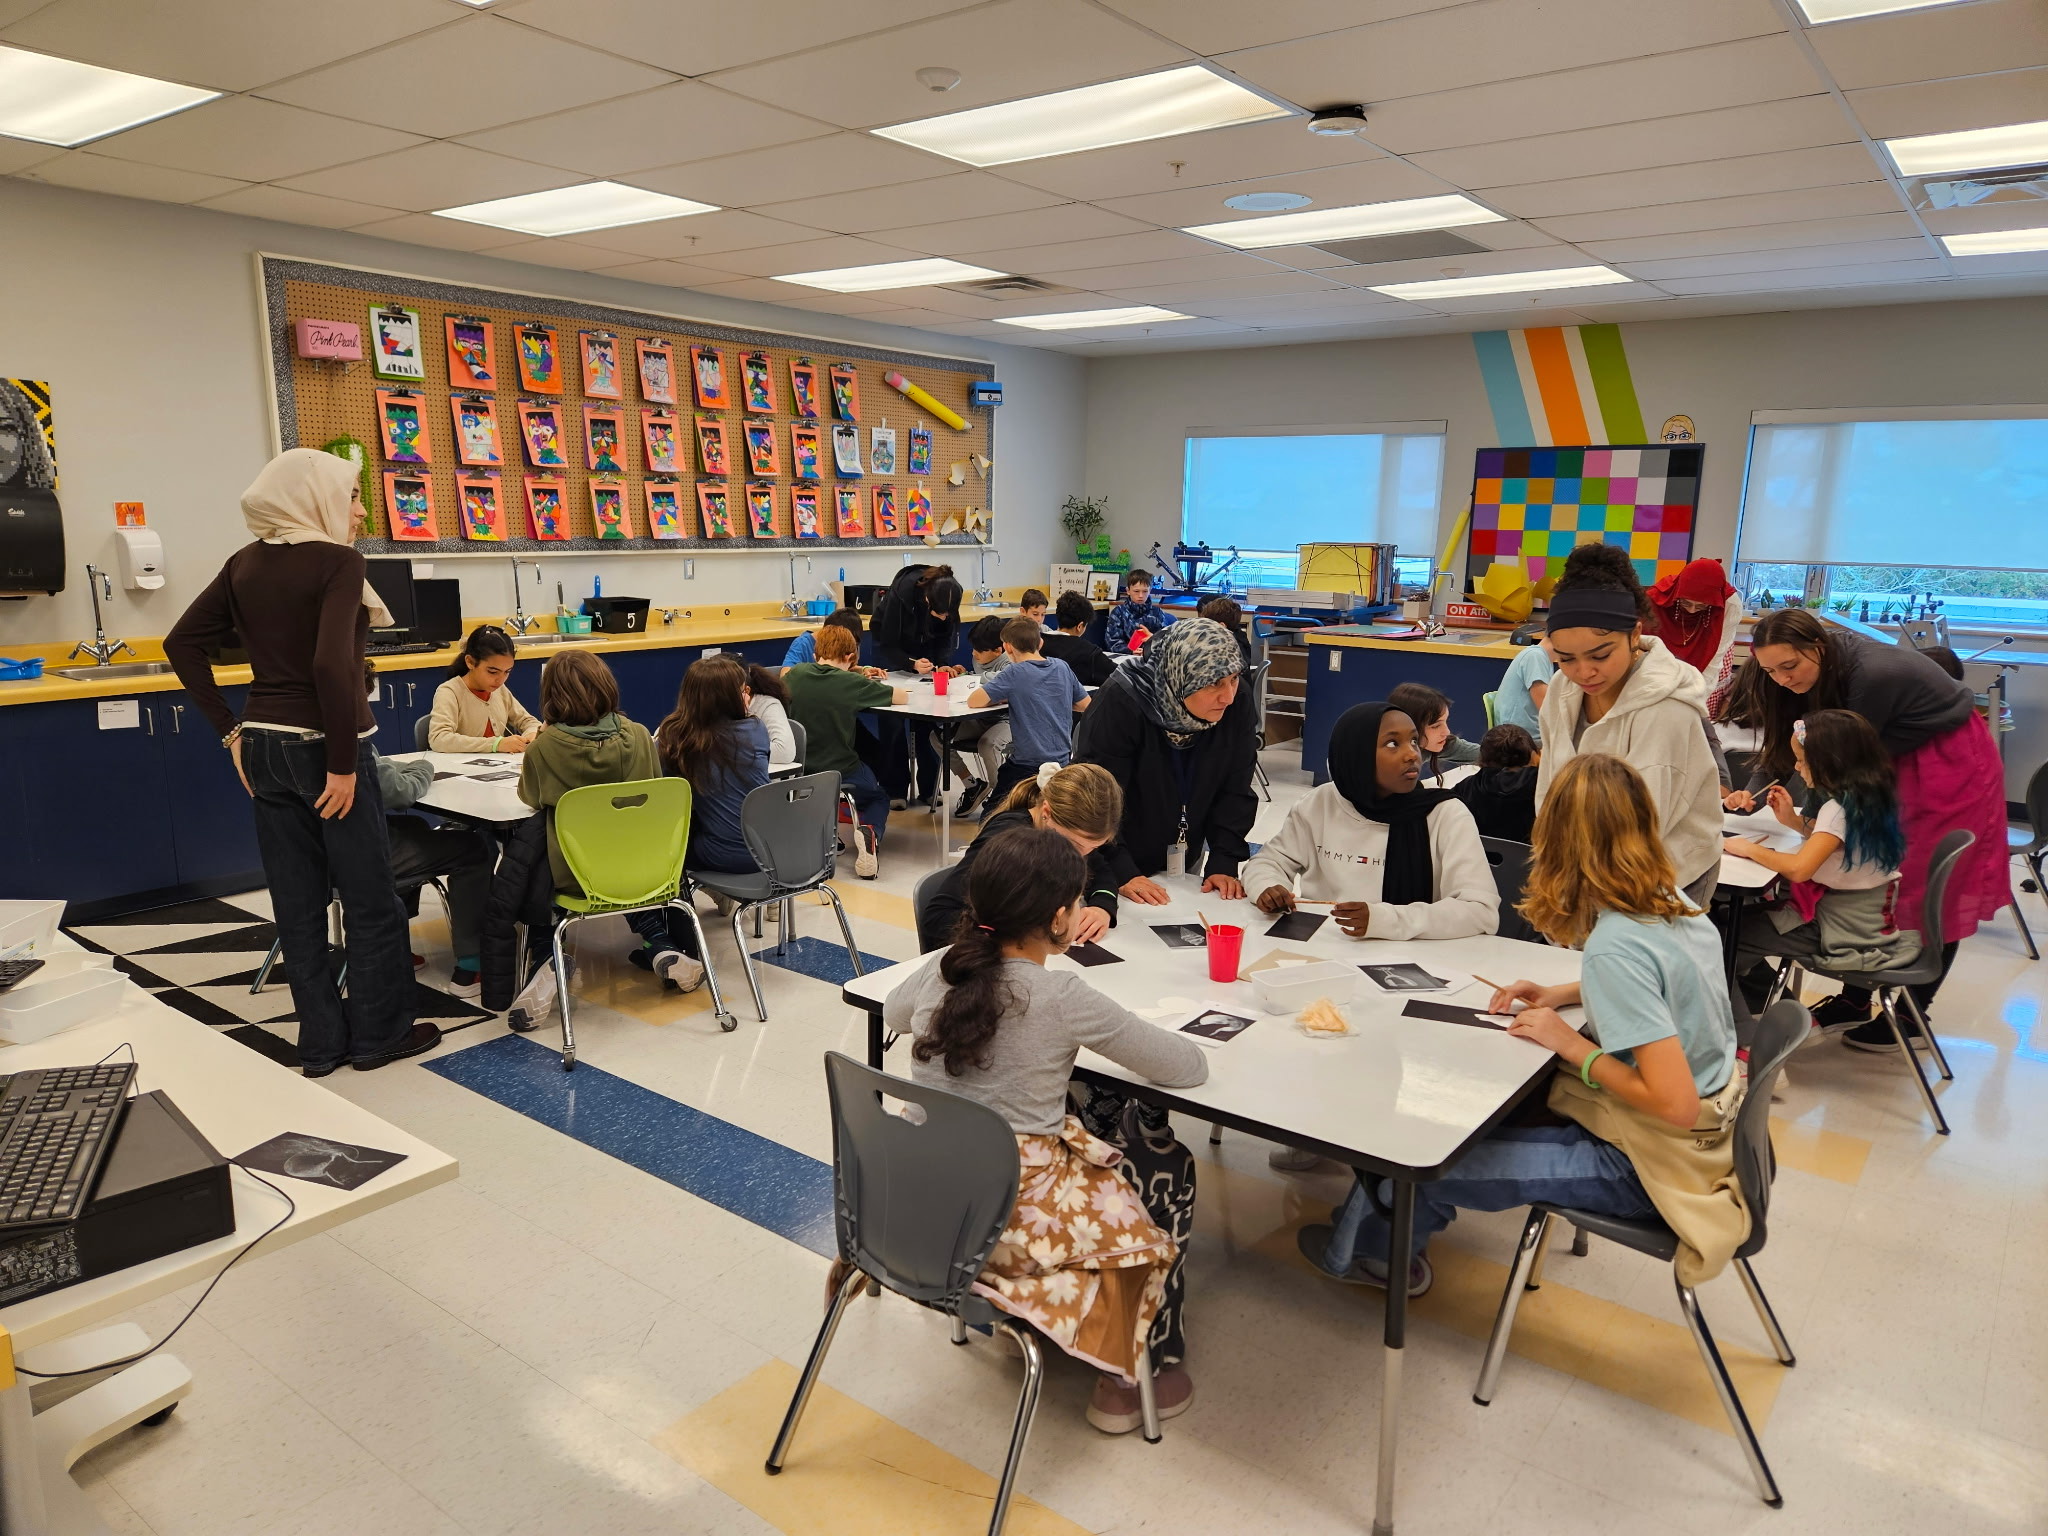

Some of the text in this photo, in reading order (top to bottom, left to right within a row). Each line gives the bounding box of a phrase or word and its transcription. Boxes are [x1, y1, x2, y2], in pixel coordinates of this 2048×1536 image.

[310, 331, 359, 348] Pink Pearl
[855, 596, 863, 610] 6
[1450, 605, 1488, 617] ON AIR
[595, 611, 603, 628] 5
[627, 612, 636, 629] 5
